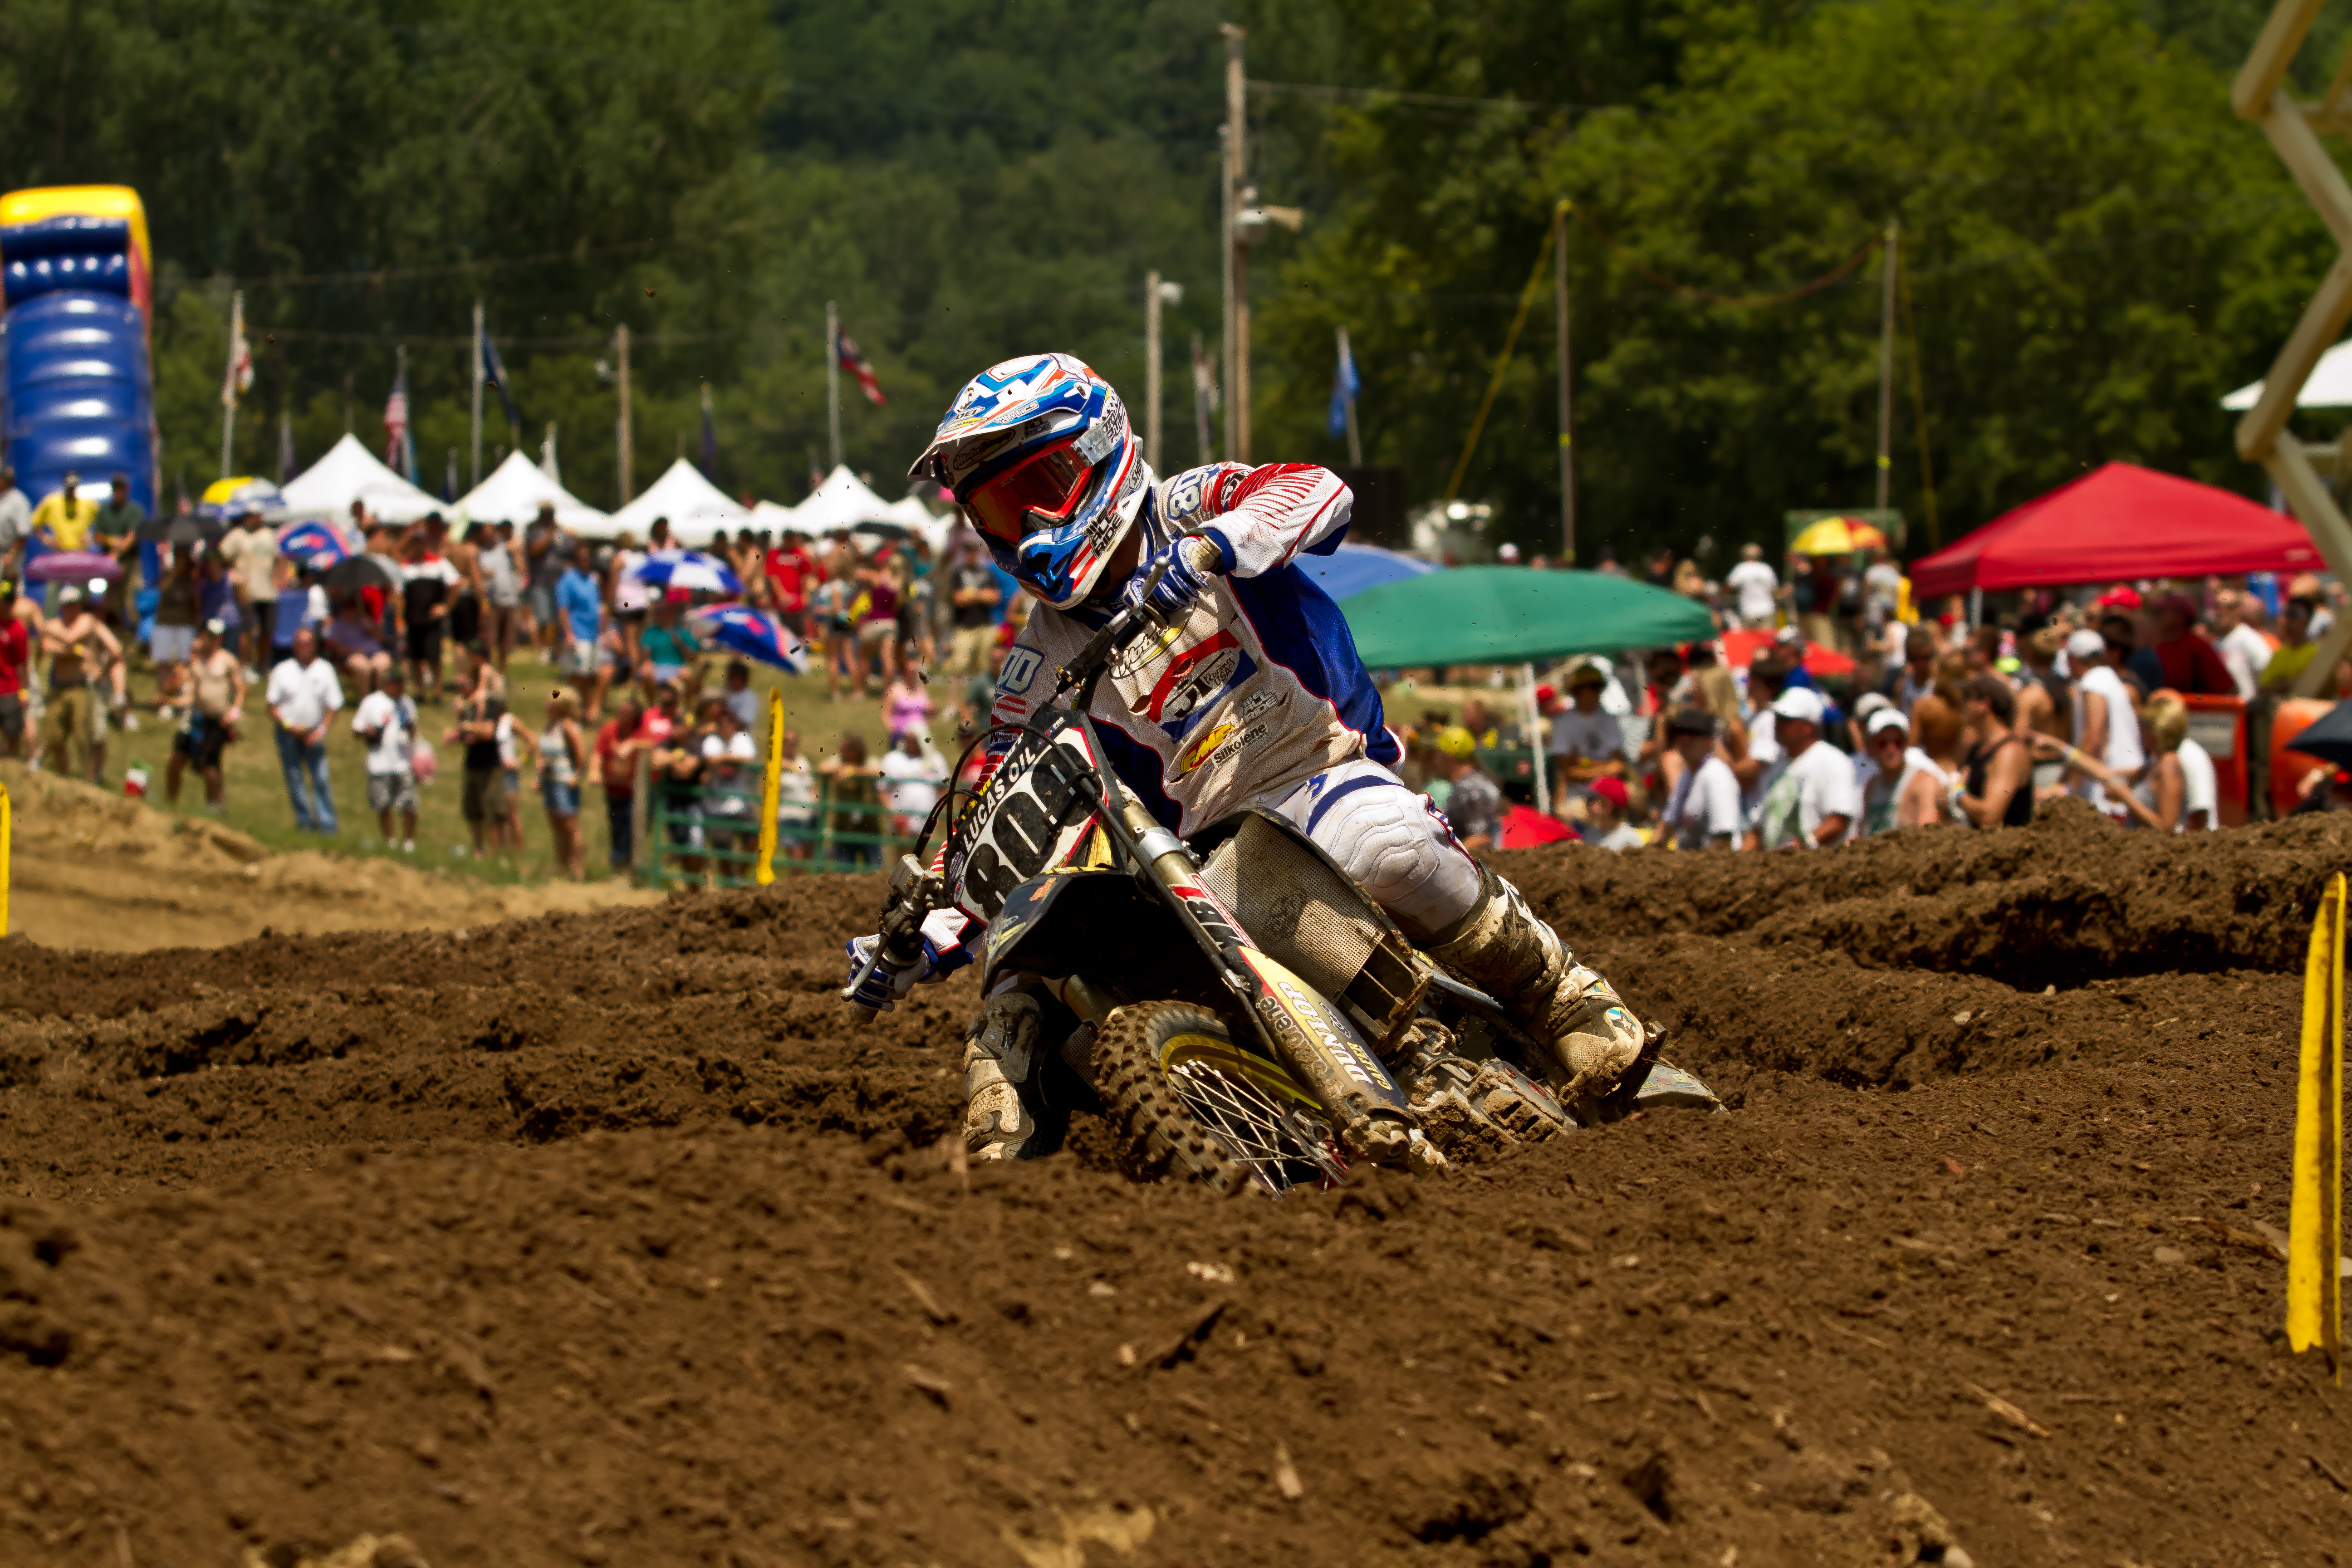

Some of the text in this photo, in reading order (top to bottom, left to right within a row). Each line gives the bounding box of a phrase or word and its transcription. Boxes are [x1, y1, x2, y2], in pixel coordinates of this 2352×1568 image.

[1092, 513, 1116, 547] ALL
[1094, 514, 1124, 557] RIDE
[1203, 657, 1236, 681] Racing
[1213, 667, 1234, 686] USA
[1244, 693, 1272, 715] ALL
[1244, 697, 1277, 724] RIDE
[1181, 722, 1231, 773] FMF
[1213, 723, 1267, 764] Silkolene
[963, 778, 1005, 853] LUCAS
[1008, 746, 1036, 783] OIL
[1278, 981, 1374, 1084] DUNLOP
[1346, 1042, 1393, 1090] GALFER
